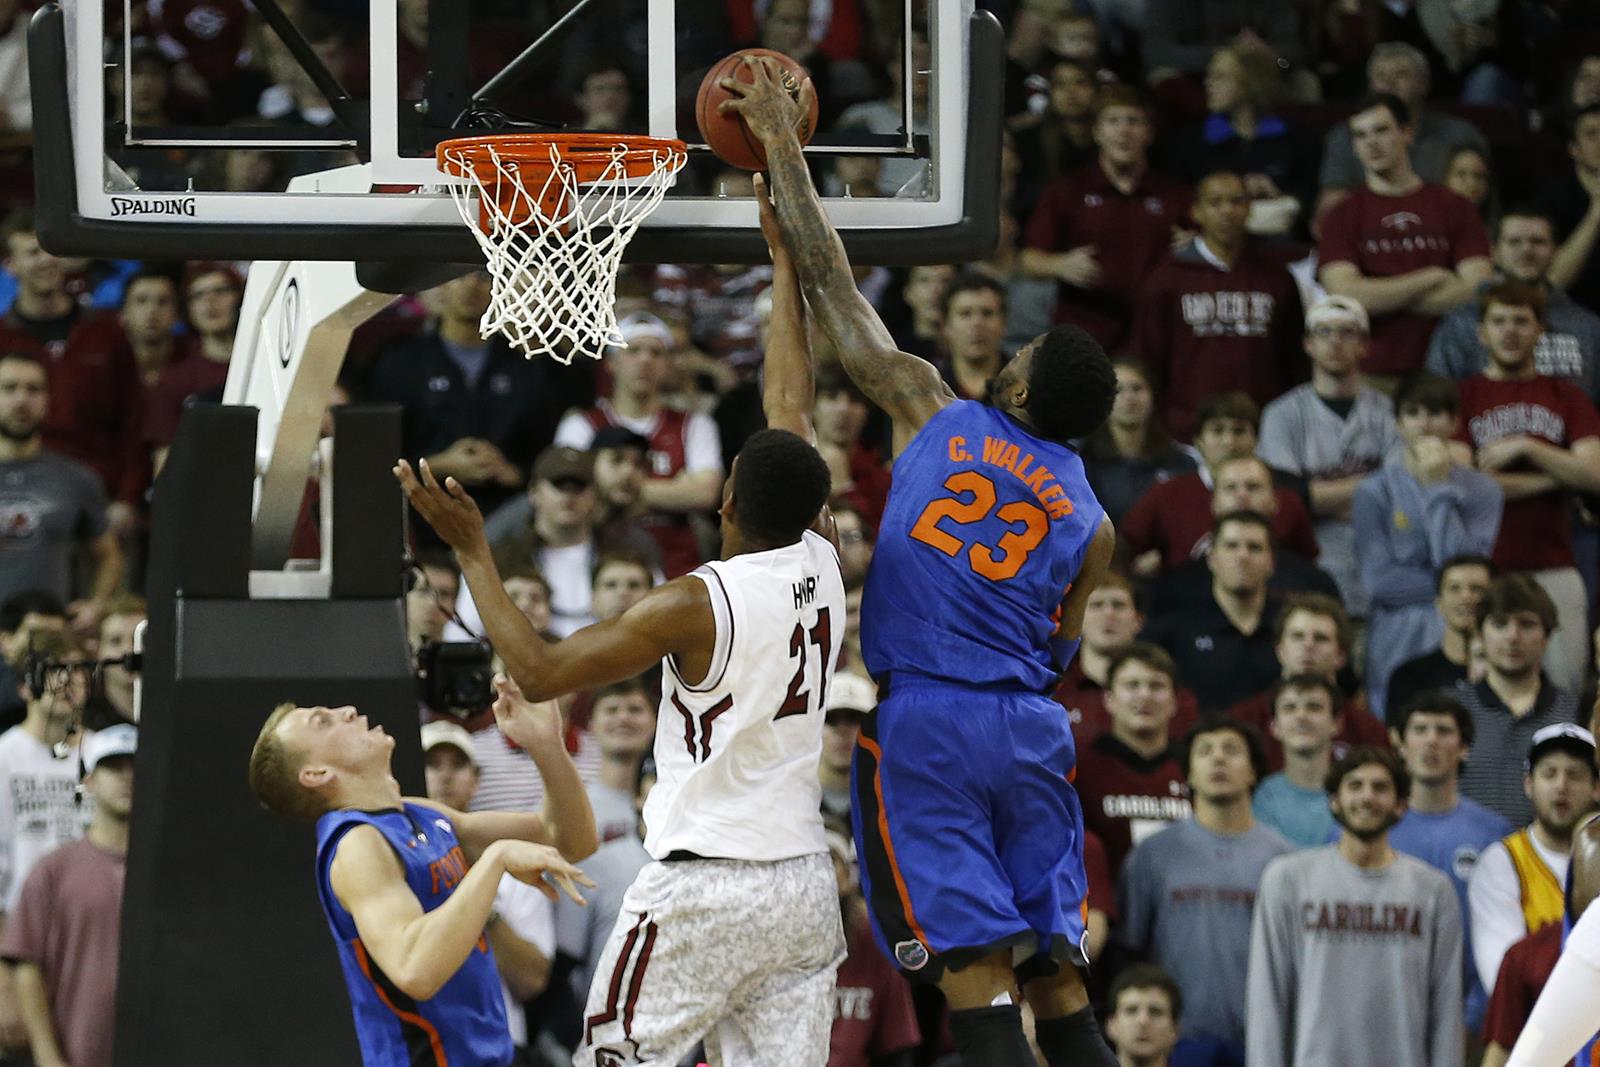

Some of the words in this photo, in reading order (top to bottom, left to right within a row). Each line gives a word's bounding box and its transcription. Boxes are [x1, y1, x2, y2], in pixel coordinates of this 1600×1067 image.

[110, 196, 197, 217] SPALDING
[948, 435, 975, 463] C.
[981, 435, 1074, 521] WALKER
[908, 469, 1050, 583] 23
[772, 605, 832, 721] 21
[1301, 901, 1422, 936] CAROLINA
